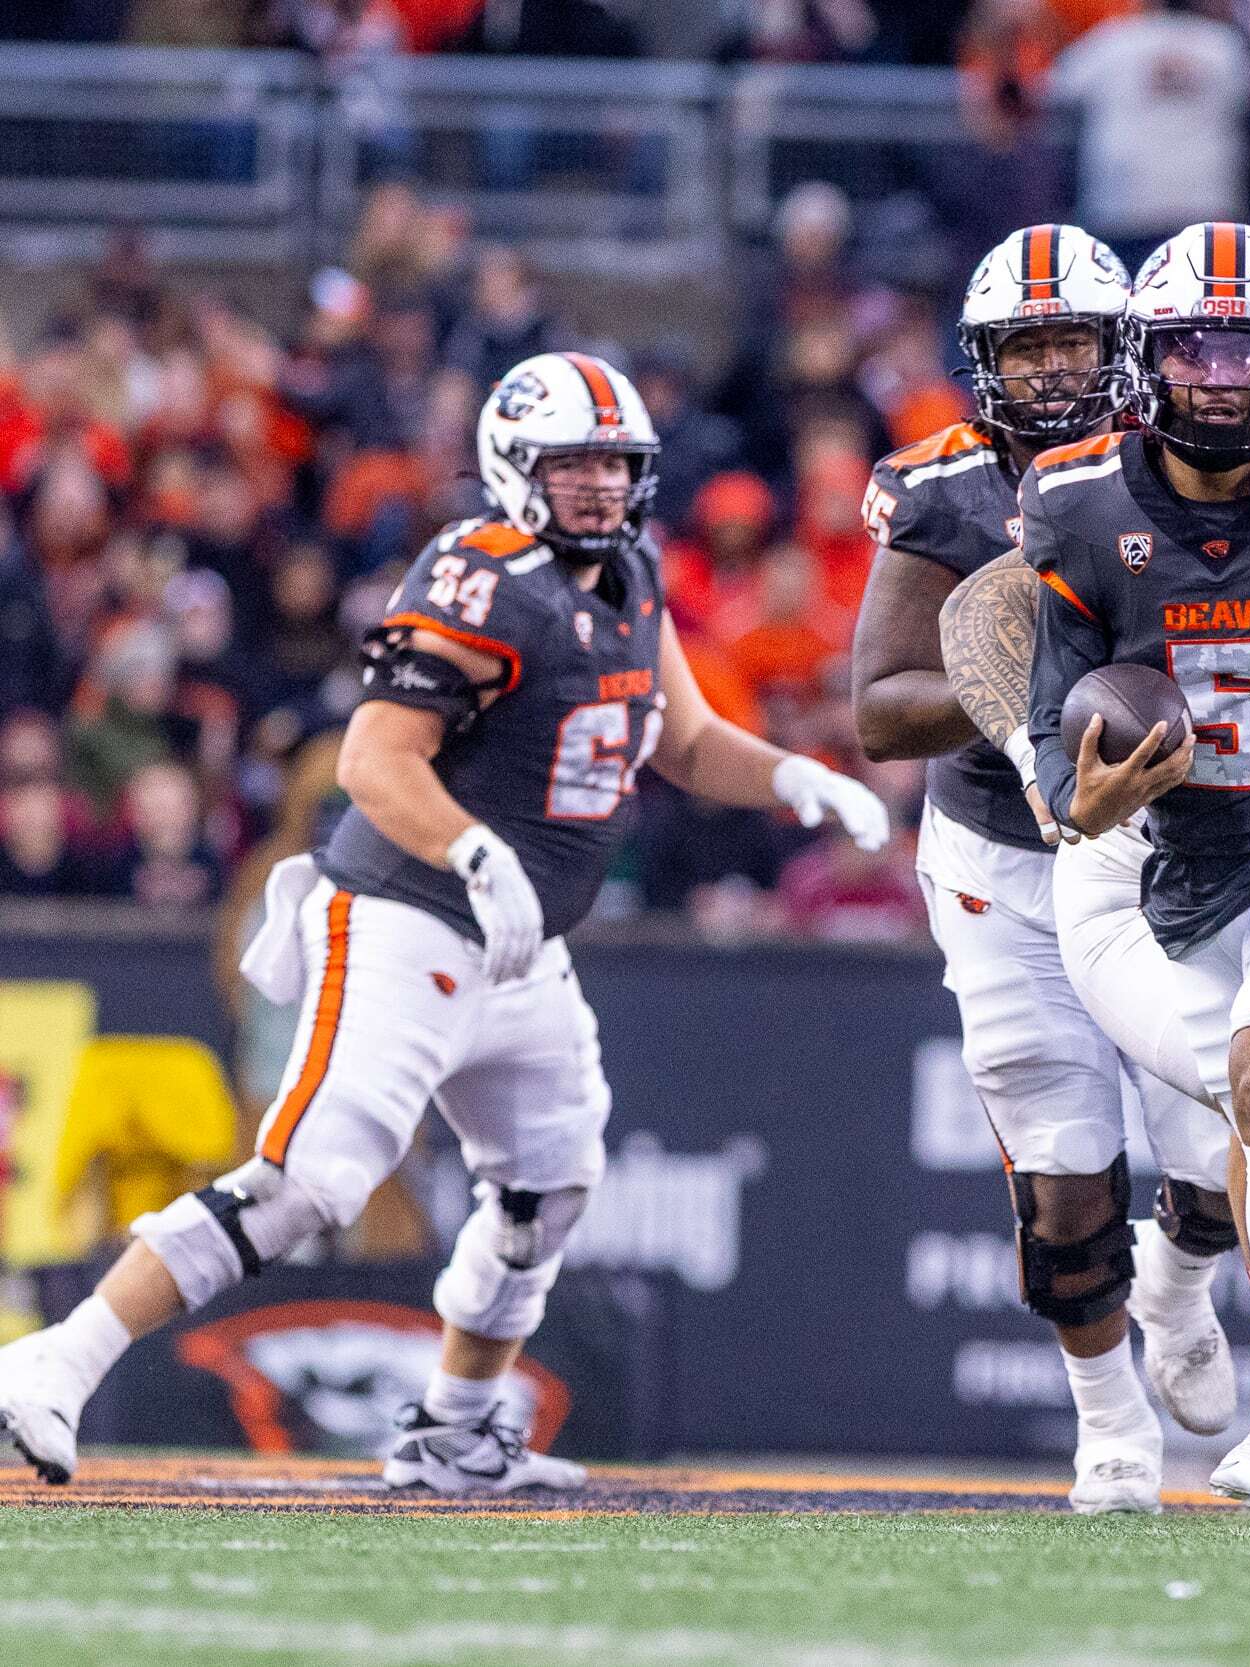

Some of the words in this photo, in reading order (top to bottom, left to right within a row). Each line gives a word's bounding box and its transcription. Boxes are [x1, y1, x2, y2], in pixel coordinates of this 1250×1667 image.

[1202, 299, 1246, 316] OSU
[1128, 550, 1145, 566] 12
[544, 692, 667, 820] 6
